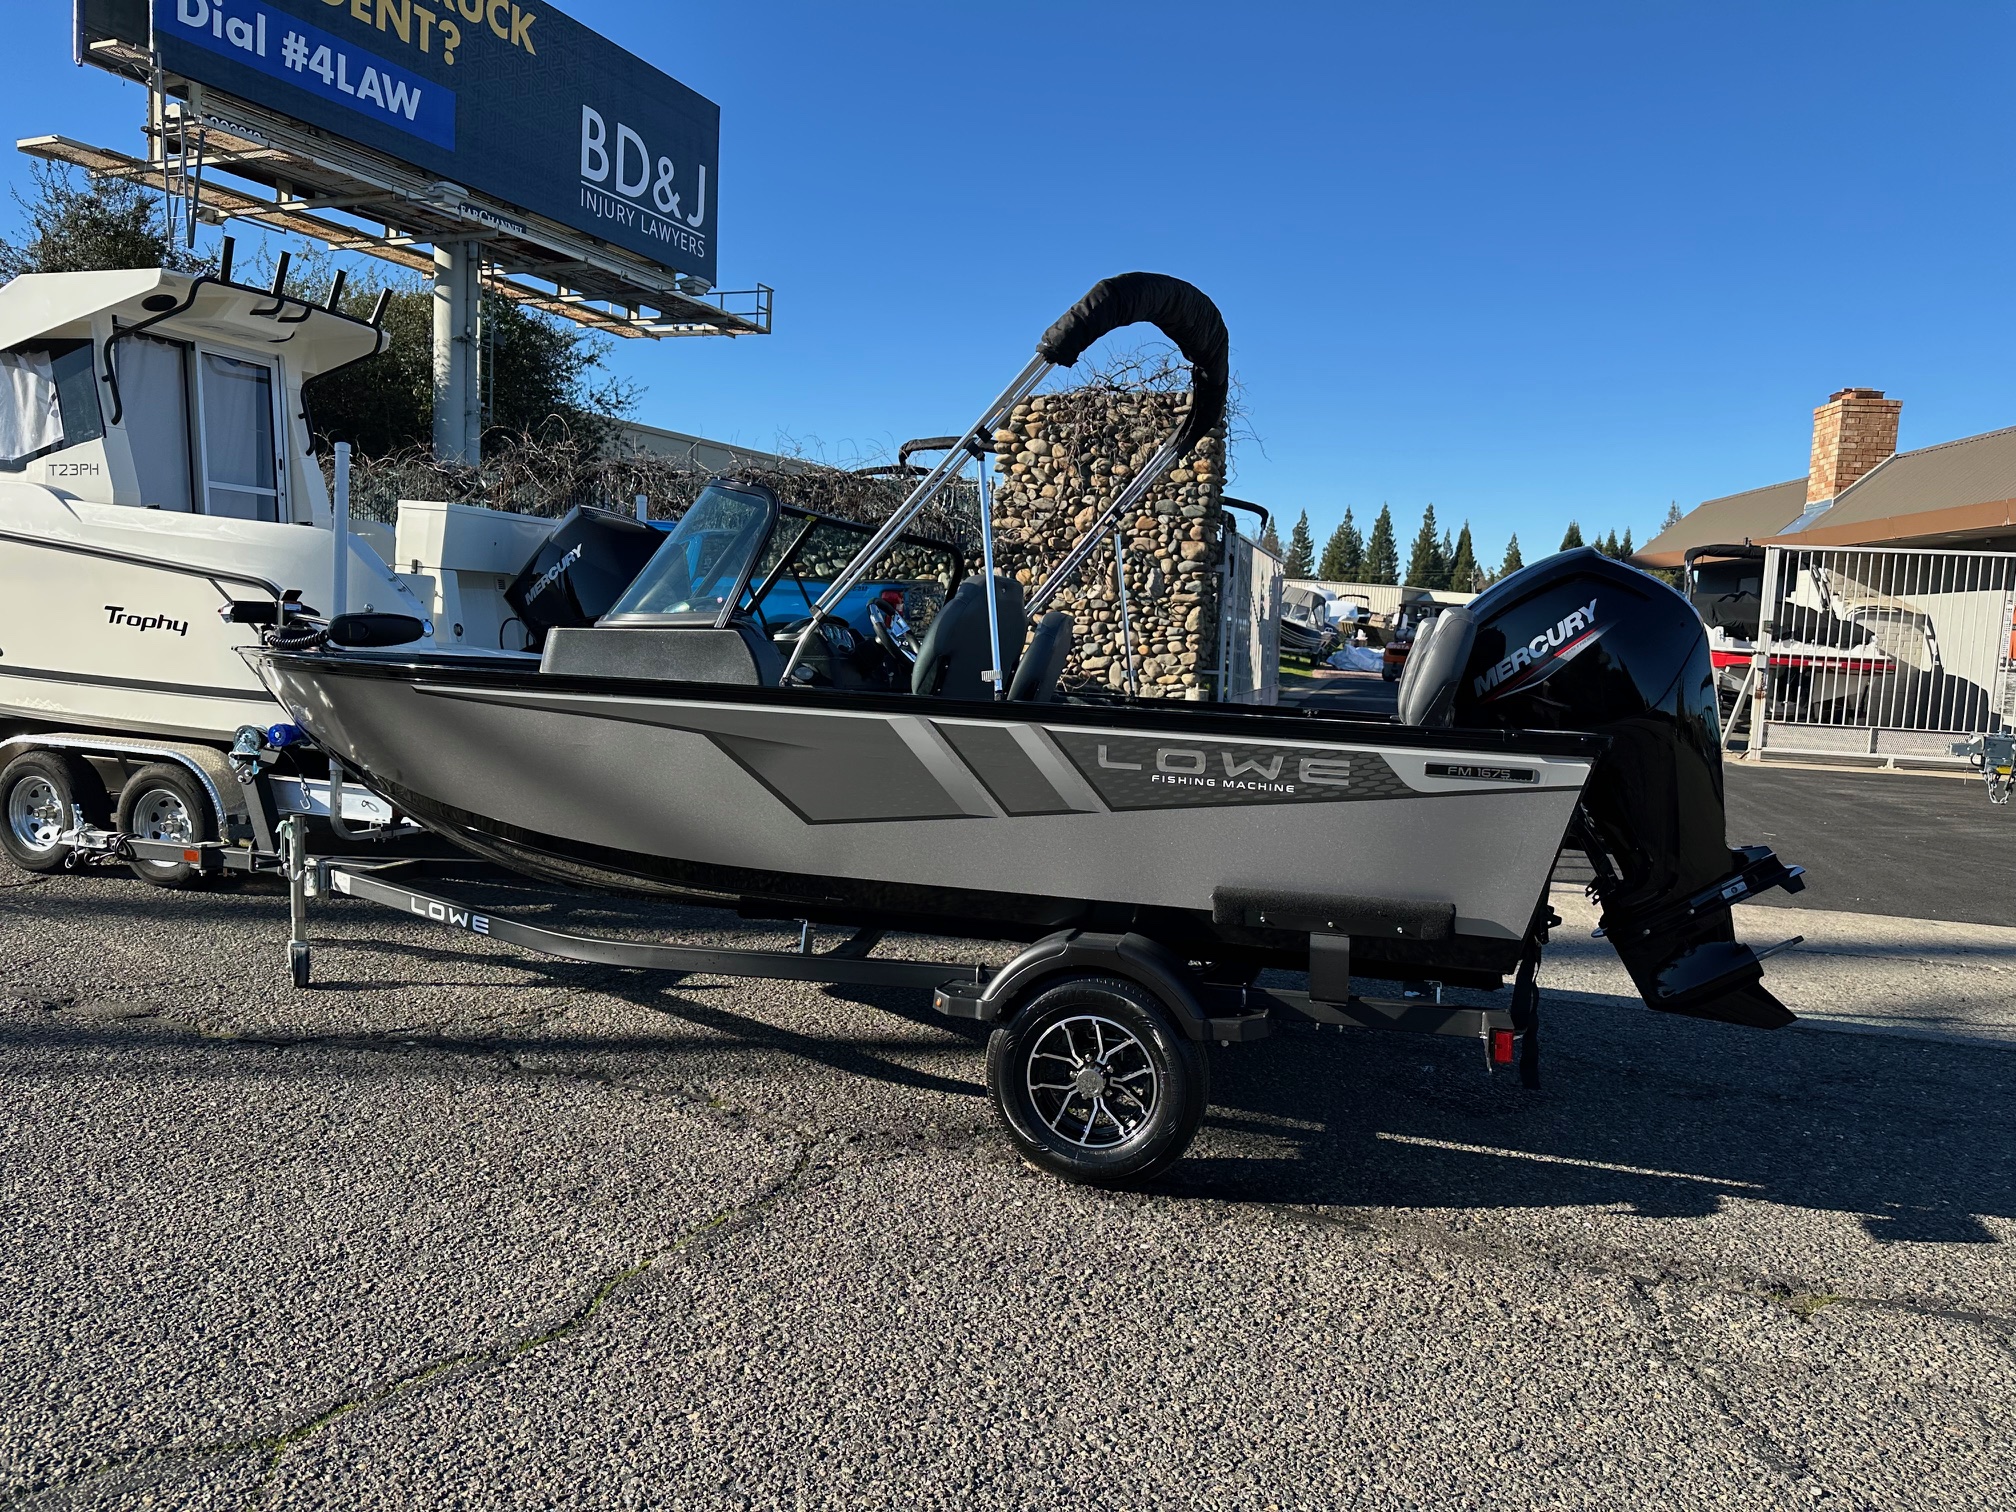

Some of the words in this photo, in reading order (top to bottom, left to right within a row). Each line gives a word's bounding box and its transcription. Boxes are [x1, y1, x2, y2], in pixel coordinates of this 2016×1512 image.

[434, 0, 537, 56] UCK
[177, 0, 266, 58] Dial
[282, 30, 421, 122] #4LAW
[580, 104, 706, 228] BD&J
[580, 187, 635, 227] INJURY
[641, 214, 705, 259] LAWYERS
[49, 463, 99, 476] T23PH
[525, 543, 582, 606] MERCURY
[104, 605, 189, 637] Trophy
[1473, 598, 1597, 697] MERCURY
[1097, 744, 1350, 786] LOWE
[1151, 774, 1216, 787] FISHING
[1222, 780, 1295, 793] MACHINE
[1447, 766, 1472, 776] FM
[1477, 768, 1511, 779] 1675
[410, 896, 489, 935] LOWE
